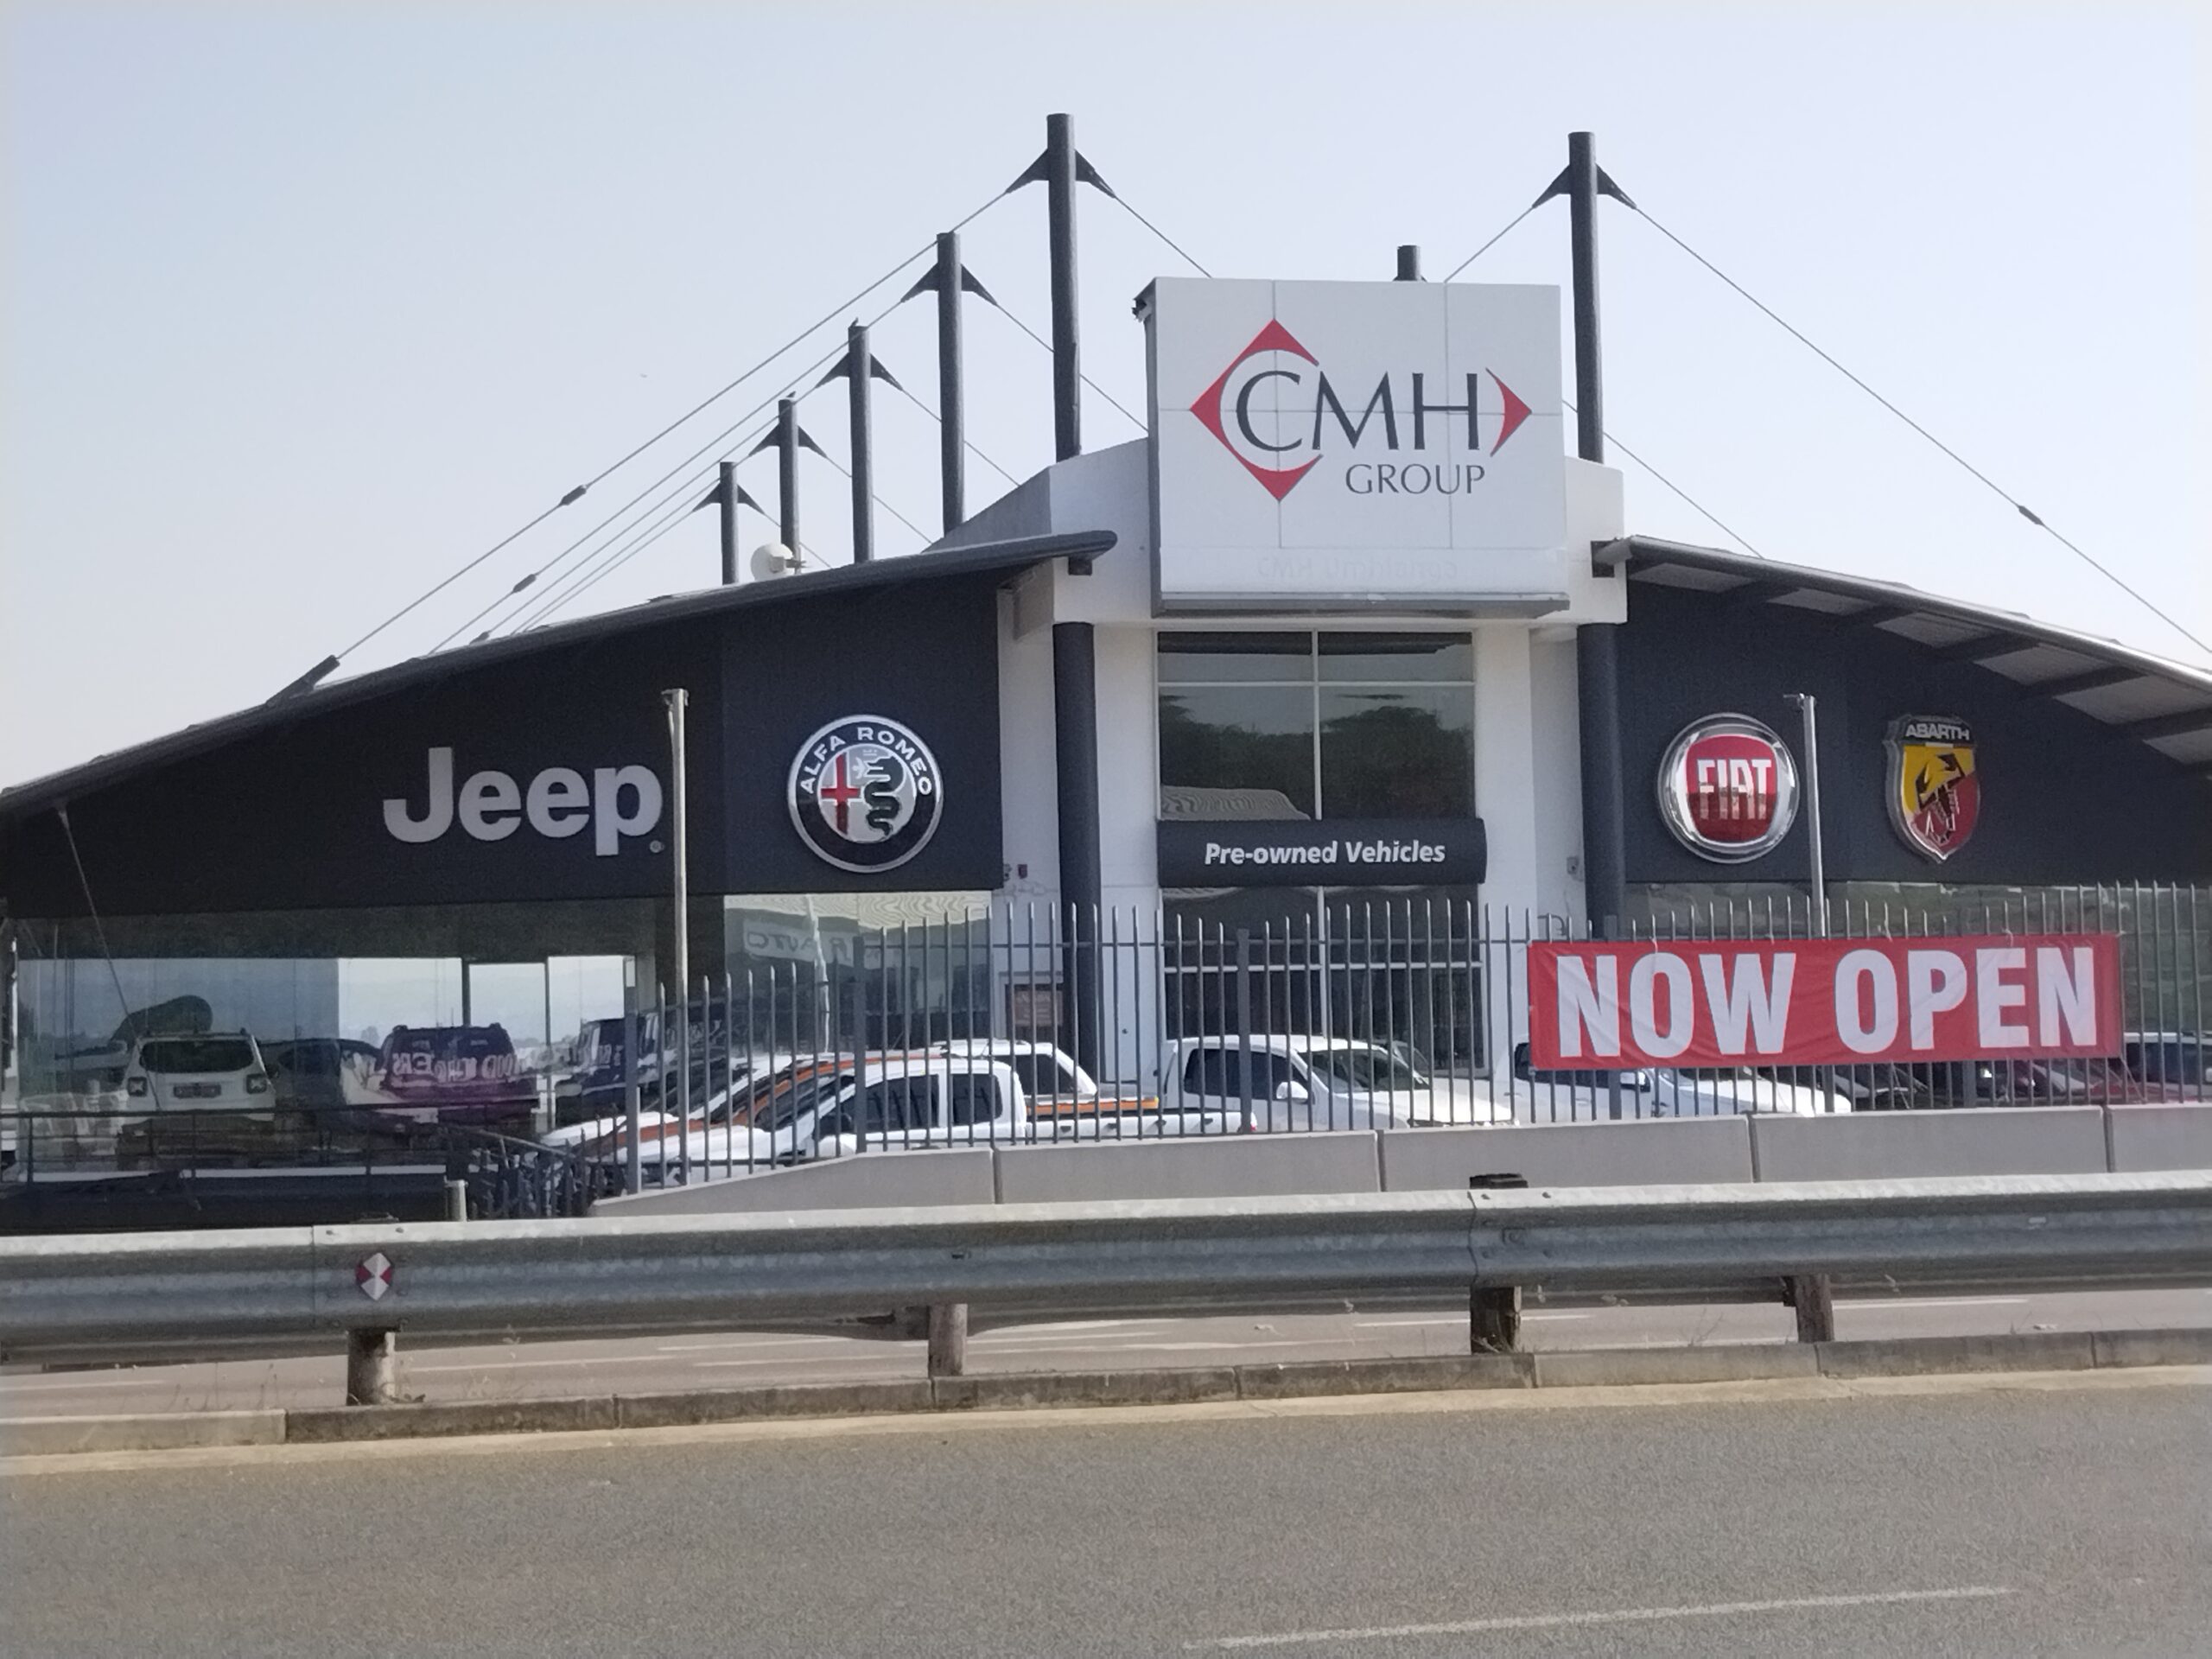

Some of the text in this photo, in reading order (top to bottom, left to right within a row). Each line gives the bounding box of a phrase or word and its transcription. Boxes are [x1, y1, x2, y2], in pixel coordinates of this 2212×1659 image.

[1236, 370, 1480, 452] CMH
[1345, 463, 1485, 495] GROUP
[800, 727, 932, 795] ALFA ROMEO
[1905, 723, 1971, 742] ABARTH
[383, 747, 663, 856] Jeep
[1696, 759, 1772, 819] FIAT
[1205, 840, 1446, 865] Pre-owned Vehicles
[1556, 946, 2097, 1058] NOW OPEN
